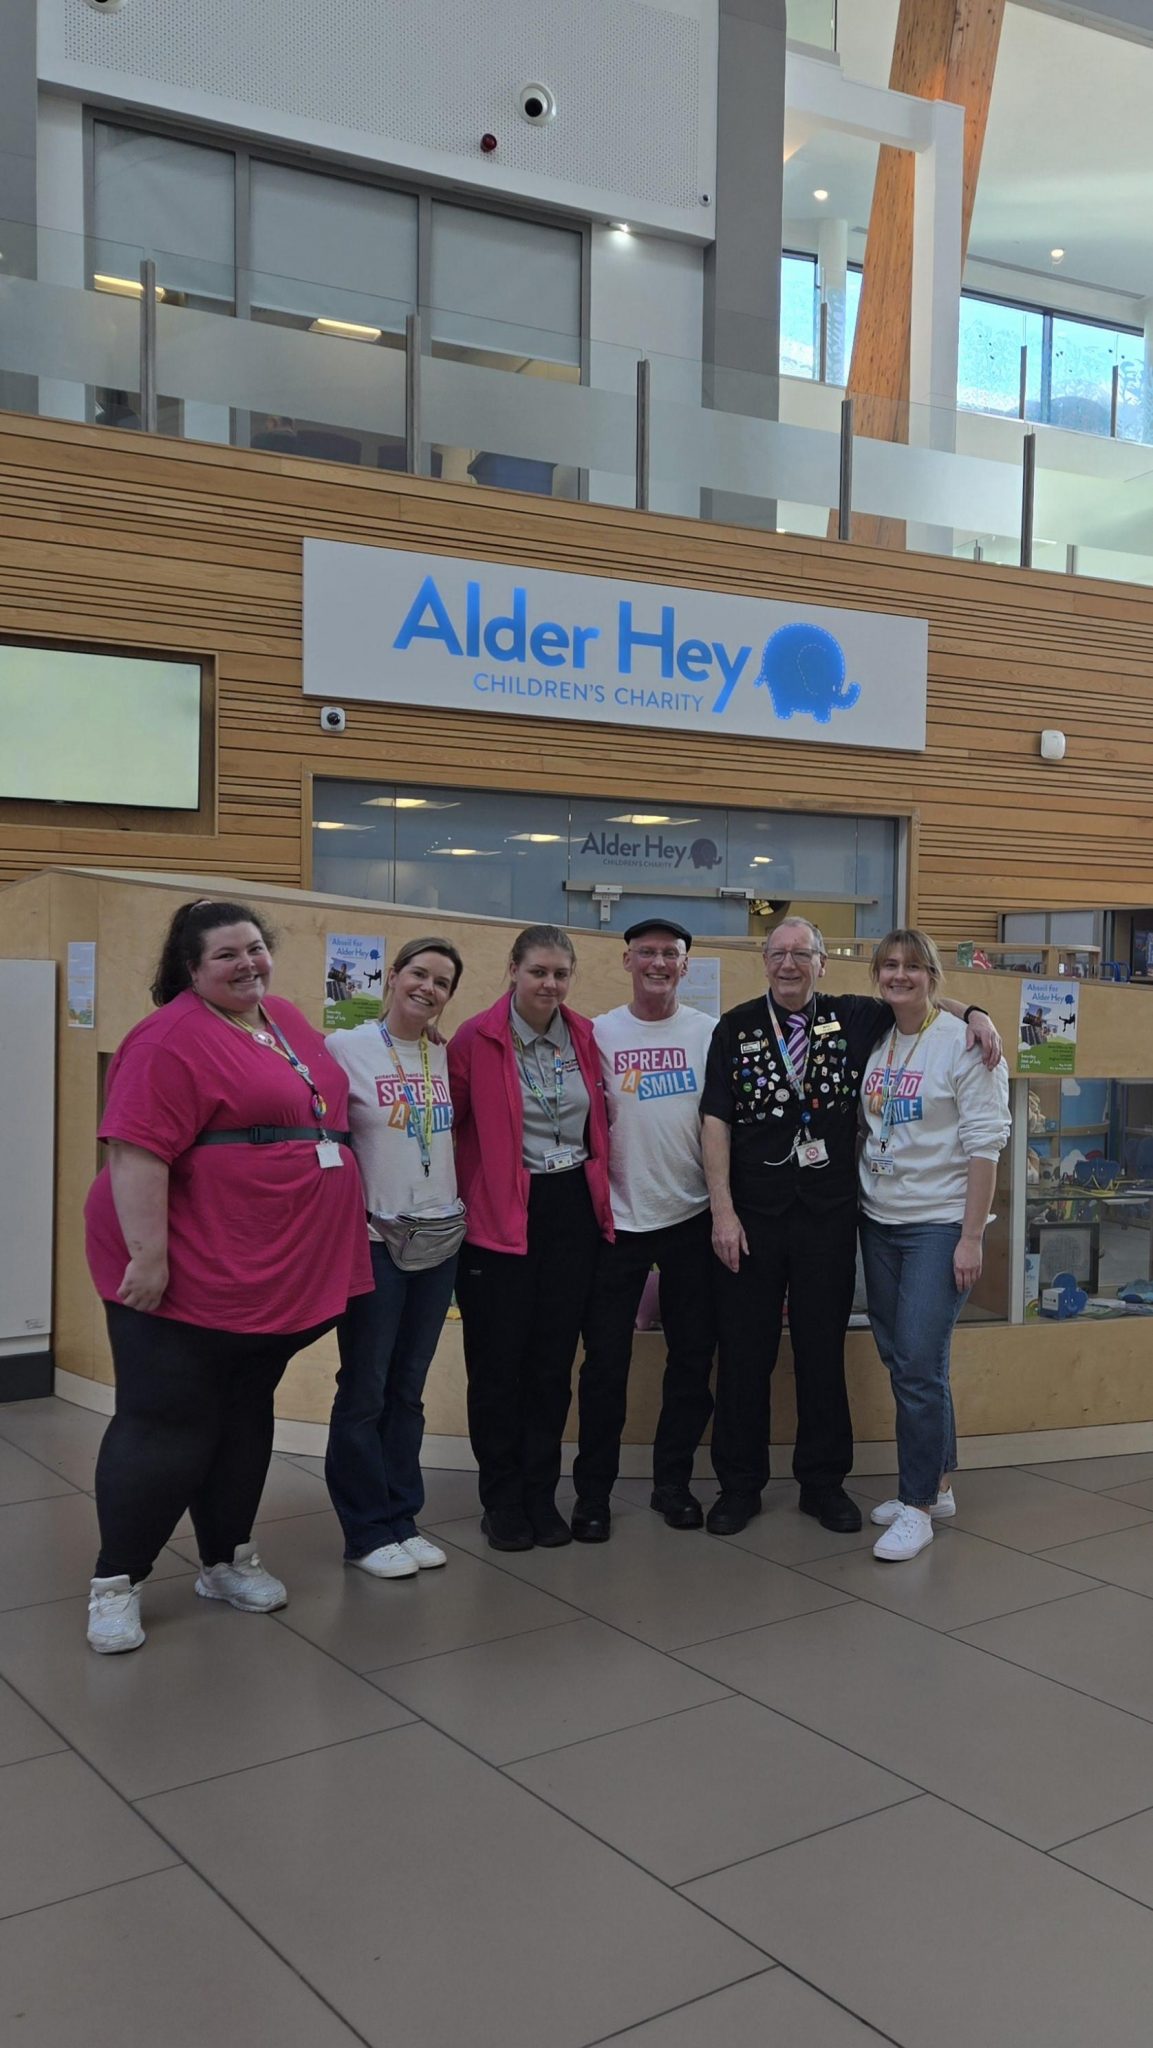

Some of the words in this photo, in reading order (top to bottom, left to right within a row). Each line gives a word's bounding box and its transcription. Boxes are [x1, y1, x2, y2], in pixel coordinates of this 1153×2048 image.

[392, 575, 600, 669] Alder
[618, 600, 752, 713] Hey
[473, 672, 605, 703] CHILDREN'S
[614, 687, 704, 712] CHARITY
[580, 832, 641, 857] Alder
[645, 834, 687, 868] Hey
[337, 947, 354, 956] Alder
[355, 948, 369, 960] Hey
[1032, 992, 1050, 1001] Alder
[1051, 993, 1064, 1004] Hey
[618, 1049, 684, 1072] SPREAD
[623, 1070, 637, 1091] A
[640, 1070, 694, 1098] SMILE
[866, 1073, 918, 1097] SPRAD
[391, 1103, 406, 1126] A
[881, 1098, 919, 1123] ILE
